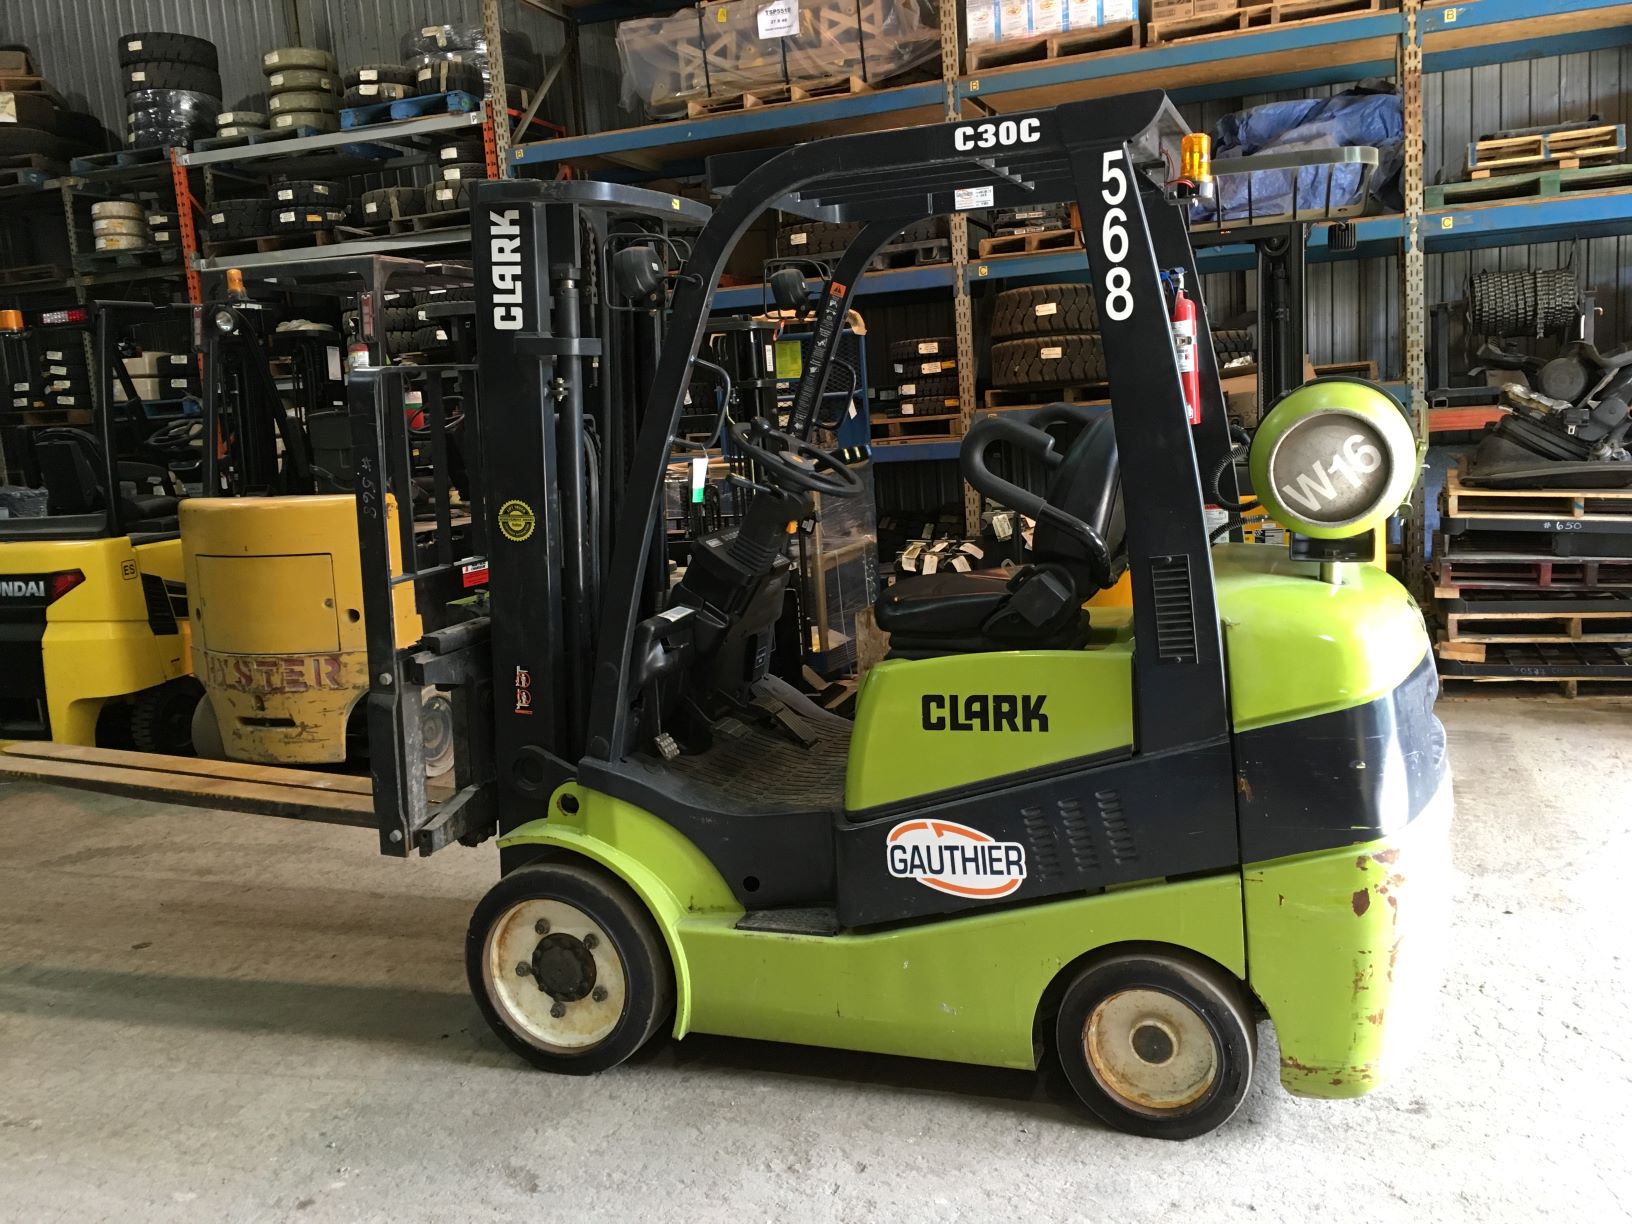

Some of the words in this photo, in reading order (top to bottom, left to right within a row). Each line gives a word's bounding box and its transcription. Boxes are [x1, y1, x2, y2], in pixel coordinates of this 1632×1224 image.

[954, 117, 1041, 151] C30C
[1101, 149, 1134, 321] 568
[489, 209, 524, 330] CLARK
[1282, 434, 1382, 512] W16
[123, 564, 135, 576] ES
[0, 580, 46, 597] NDAI
[921, 694, 1049, 732] CLARK
[889, 844, 1024, 876] GAUTHIER
